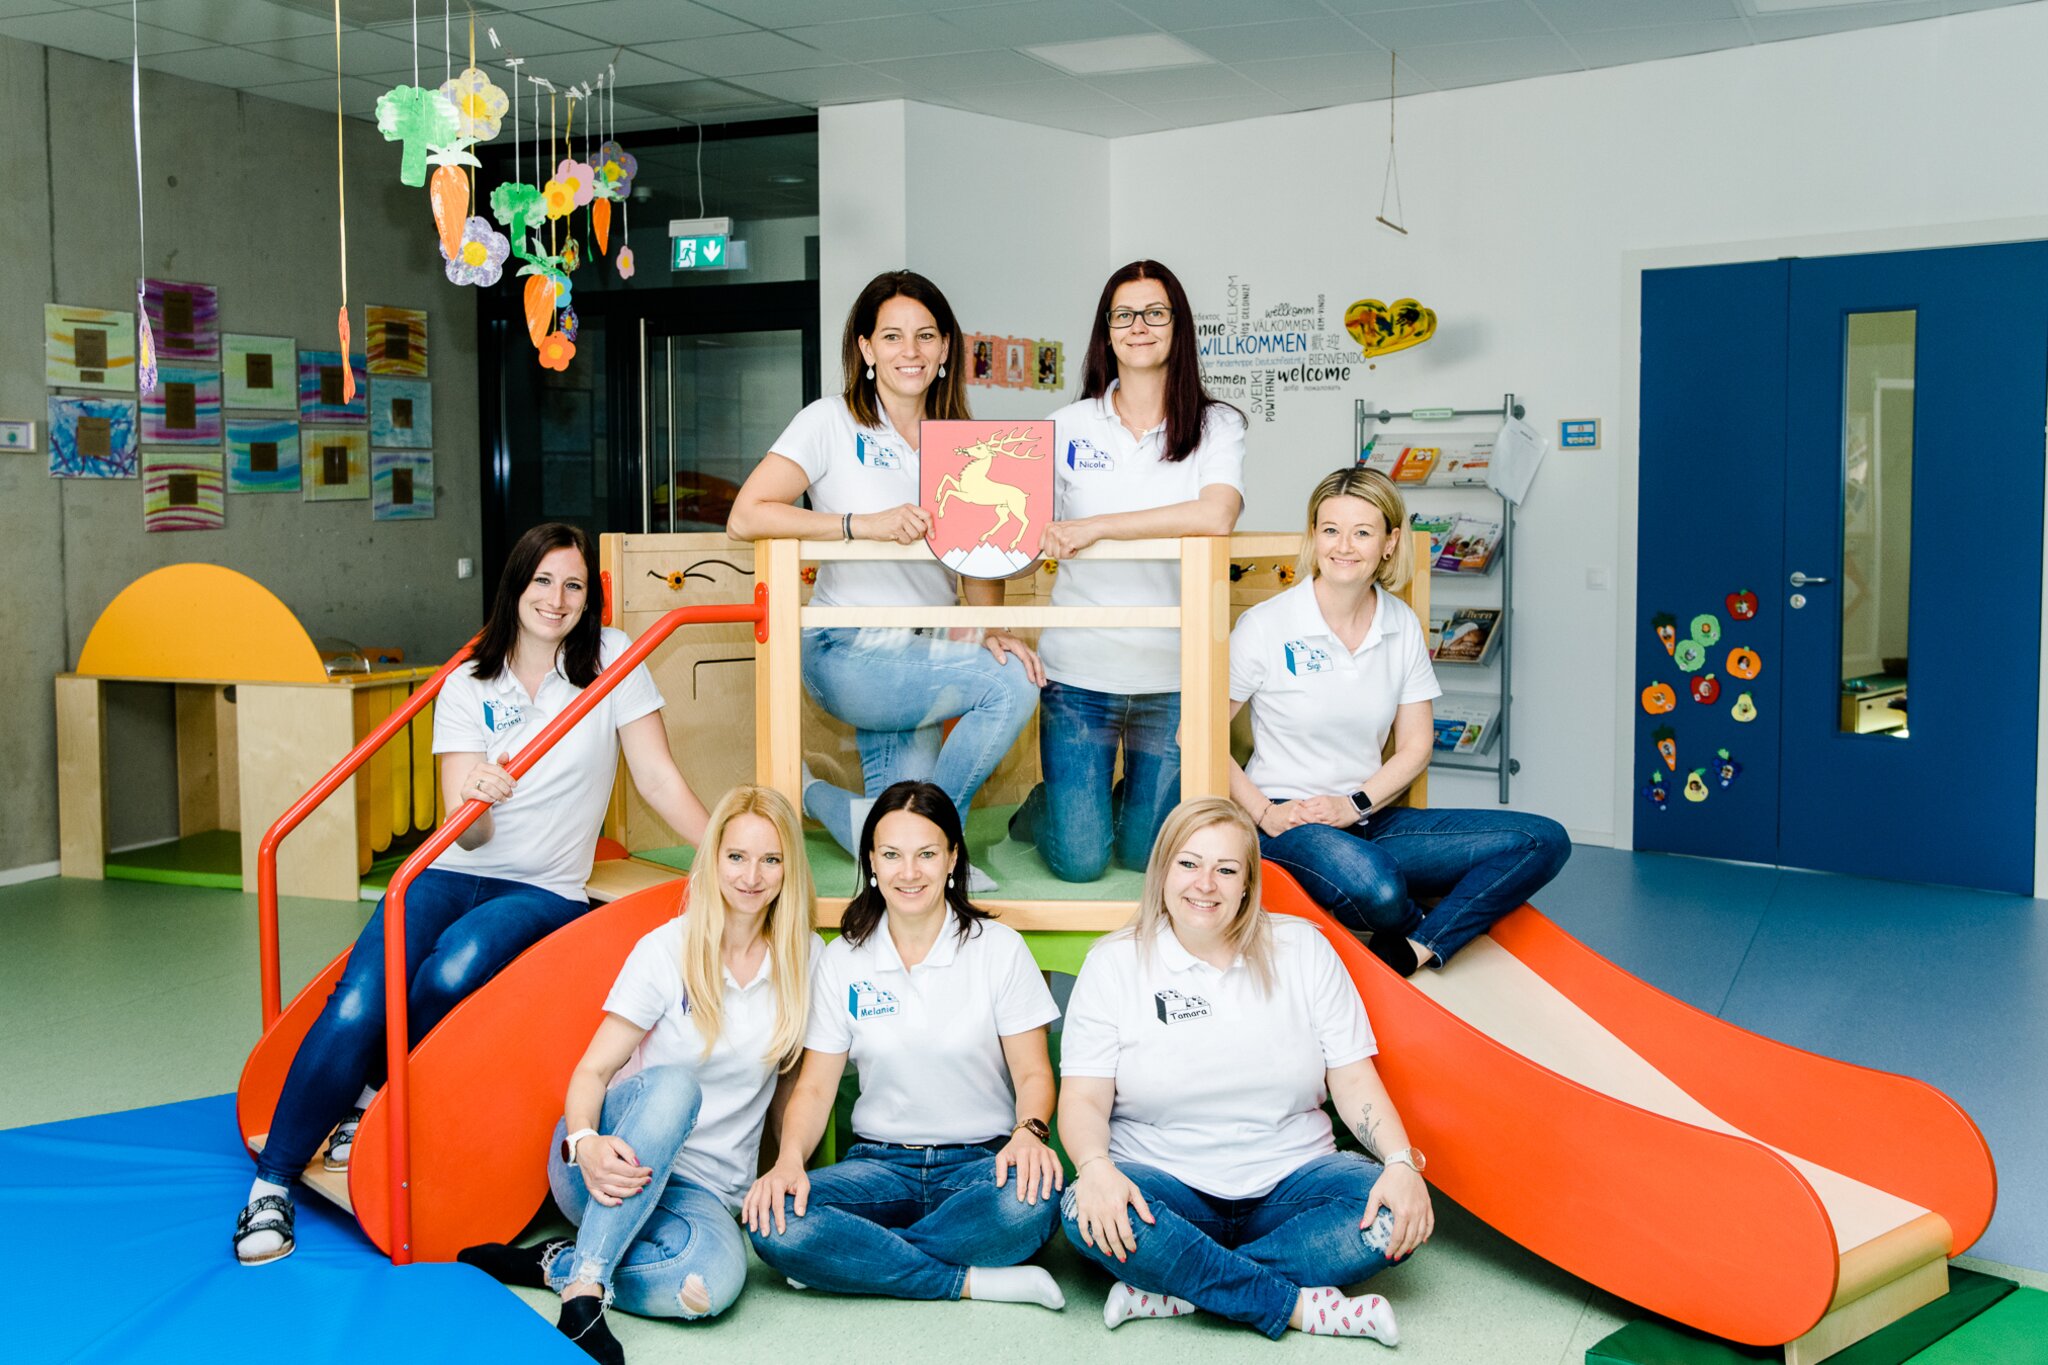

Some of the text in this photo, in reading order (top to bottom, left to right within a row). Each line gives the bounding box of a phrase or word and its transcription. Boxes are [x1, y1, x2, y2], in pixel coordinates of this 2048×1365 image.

[1227, 275, 1239, 337] WELKOM
[1197, 322, 1226, 336] nue
[1198, 332, 1307, 356] WILLKOMMEN
[1308, 351, 1366, 366] BIENVENIDO
[1278, 363, 1351, 383] welcome
[1250, 370, 1263, 414] SVEIKI
[1265, 368, 1276, 422] POWITANIE
[861, 1005, 895, 1017] Melanie
[1170, 1009, 1207, 1020] Tamara
